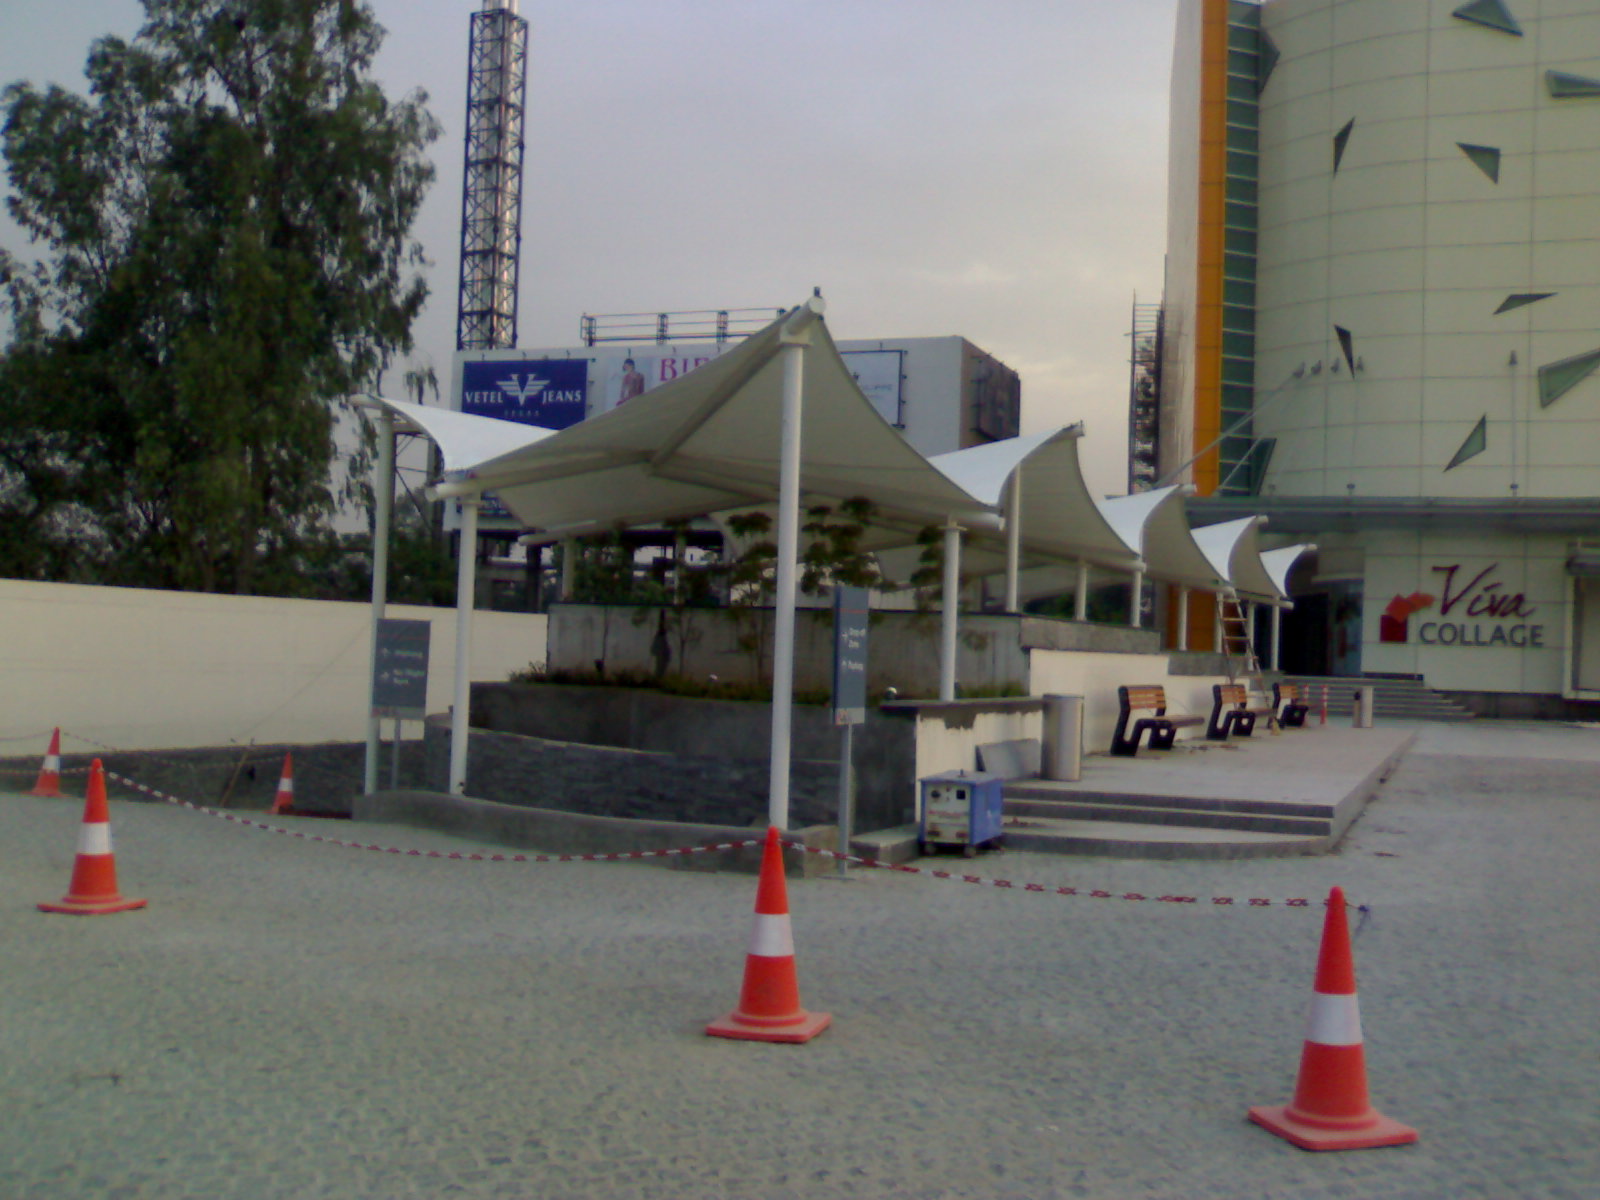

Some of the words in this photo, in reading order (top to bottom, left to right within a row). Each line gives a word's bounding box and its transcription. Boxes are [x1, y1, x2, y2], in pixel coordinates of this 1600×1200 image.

[464, 391, 503, 403] VETEL
[541, 389, 582, 404] JEANS
[1420, 622, 1544, 647] COLLAGE
